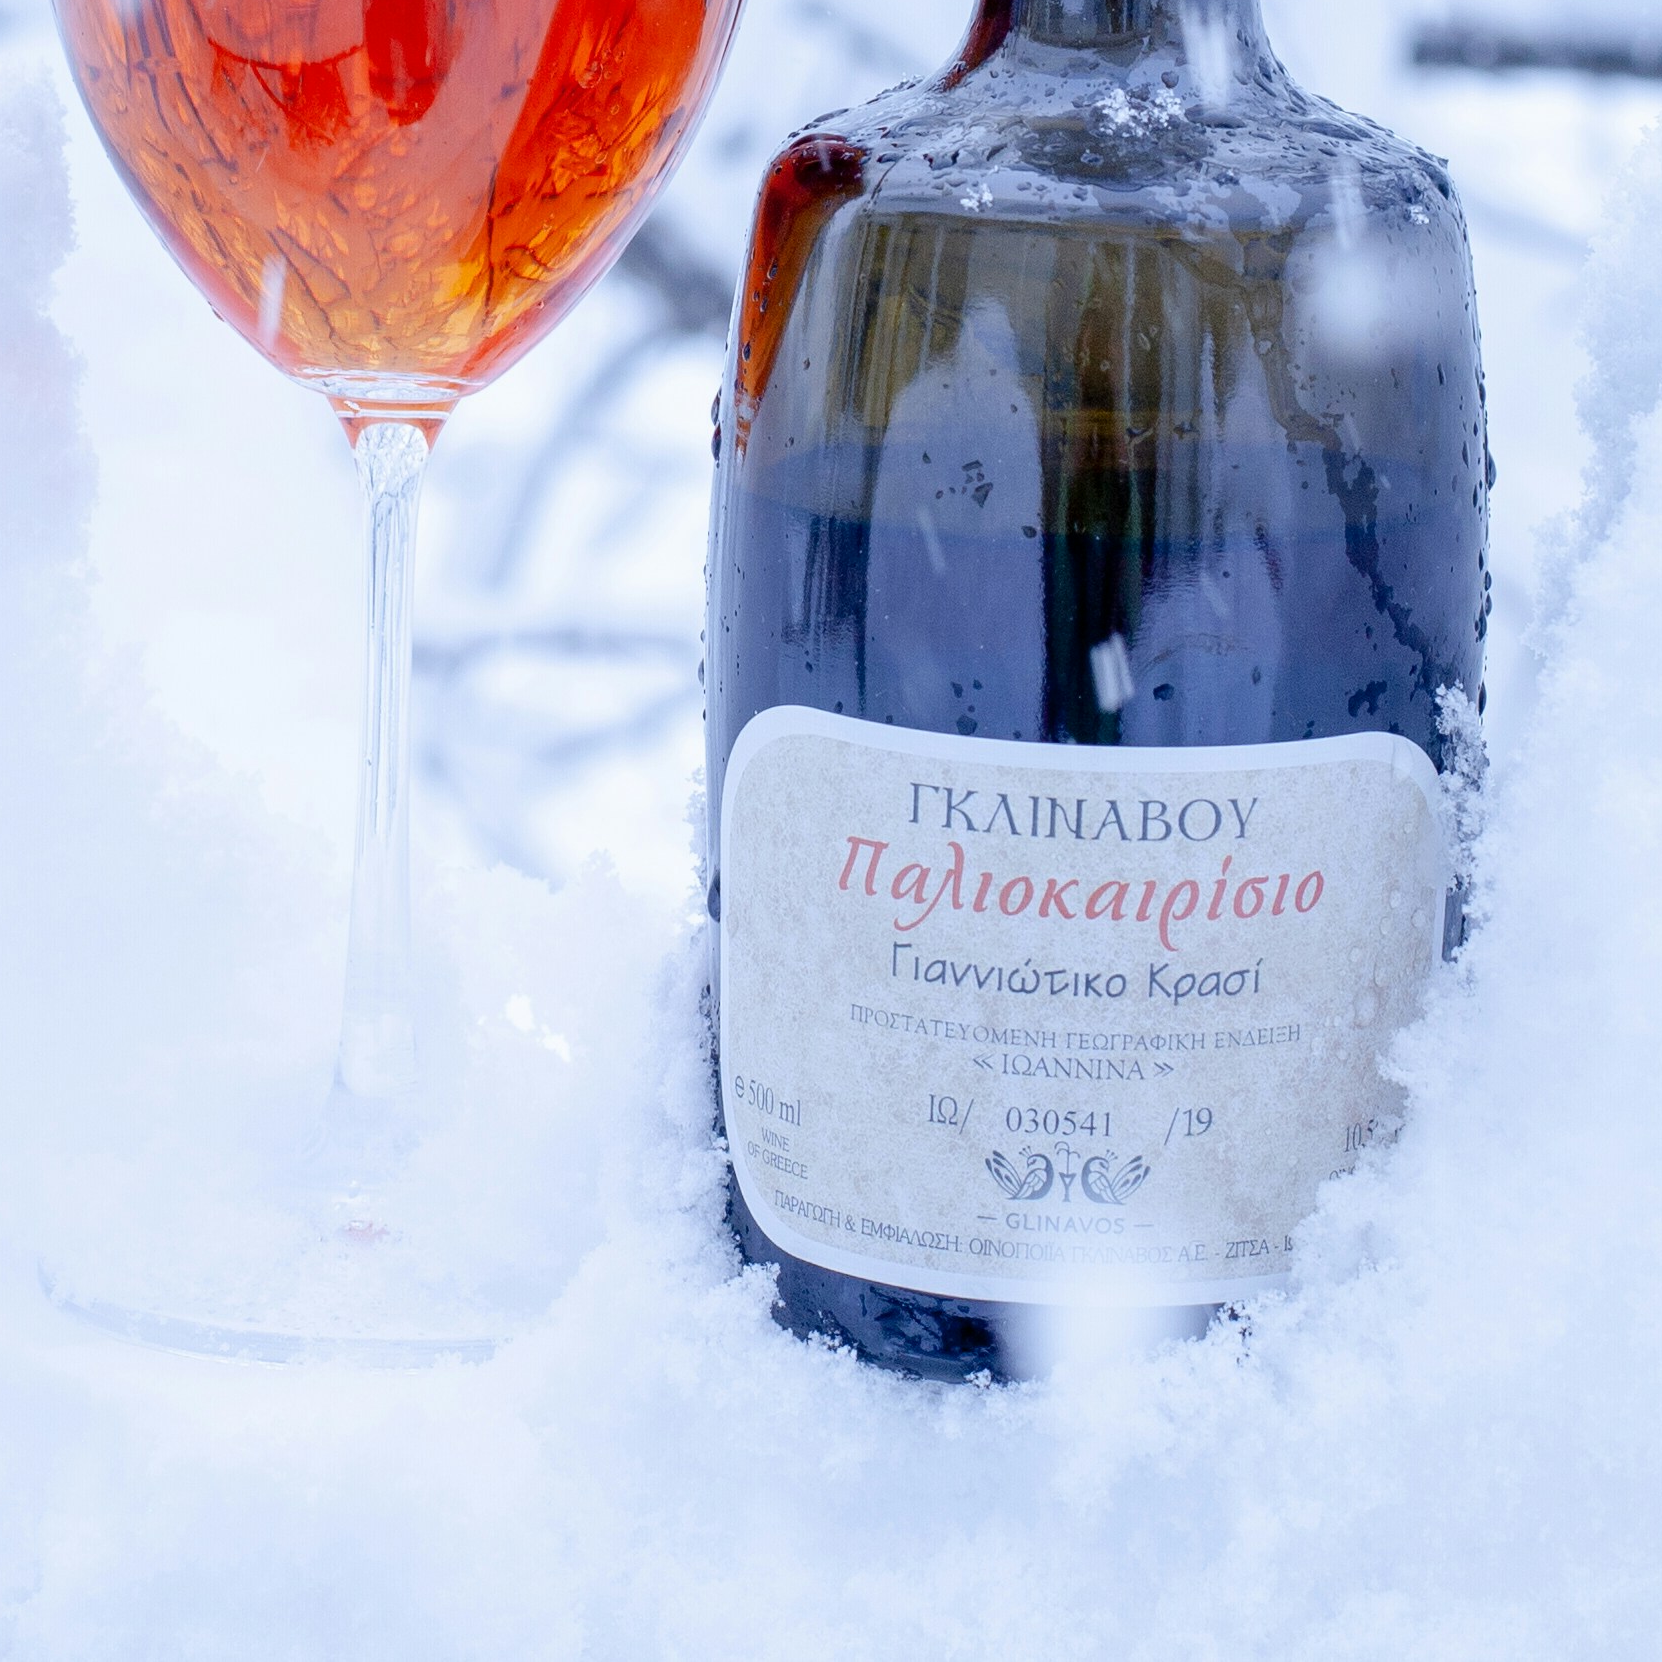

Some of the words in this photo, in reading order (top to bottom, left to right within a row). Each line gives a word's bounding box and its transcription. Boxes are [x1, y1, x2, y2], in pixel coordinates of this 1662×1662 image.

[908, 782, 1259, 843] ΓΚΛΙΝΑΒΟΥ
[838, 835, 1325, 952] Παλιοκαιρίσιο
[891, 941, 1128, 1000] Γιαννιώτικο
[1148, 958, 1263, 1006] Κρασί
[850, 1003, 1057, 1050] ΠΡΟΣΤΑΤΕΥΟΜΕΝΗ
[1065, 1030, 1206, 1052] ΓΕΩΓΡΑΦΙΚΗ
[1214, 1023, 1302, 1050] ΕΝΔΕΙΞΗ
[748, 1079, 774, 1115] 500
[779, 1099, 802, 1127] ml
[1005, 1105, 1113, 1137] 030541
[1163, 1106, 1214, 1146] /19
[747, 1140, 761, 1157] OF
[762, 1149, 808, 1180] GREECE
[761, 1126, 790, 1153] WINE
[774, 1189, 840, 1228] ΠΑΡΑΓΩΓΗ
[844, 1214, 856, 1232] &
[1224, 1238, 1270, 1261] ΖΙΤΣΑ
[1005, 1212, 1126, 1235] GLINAVOS
